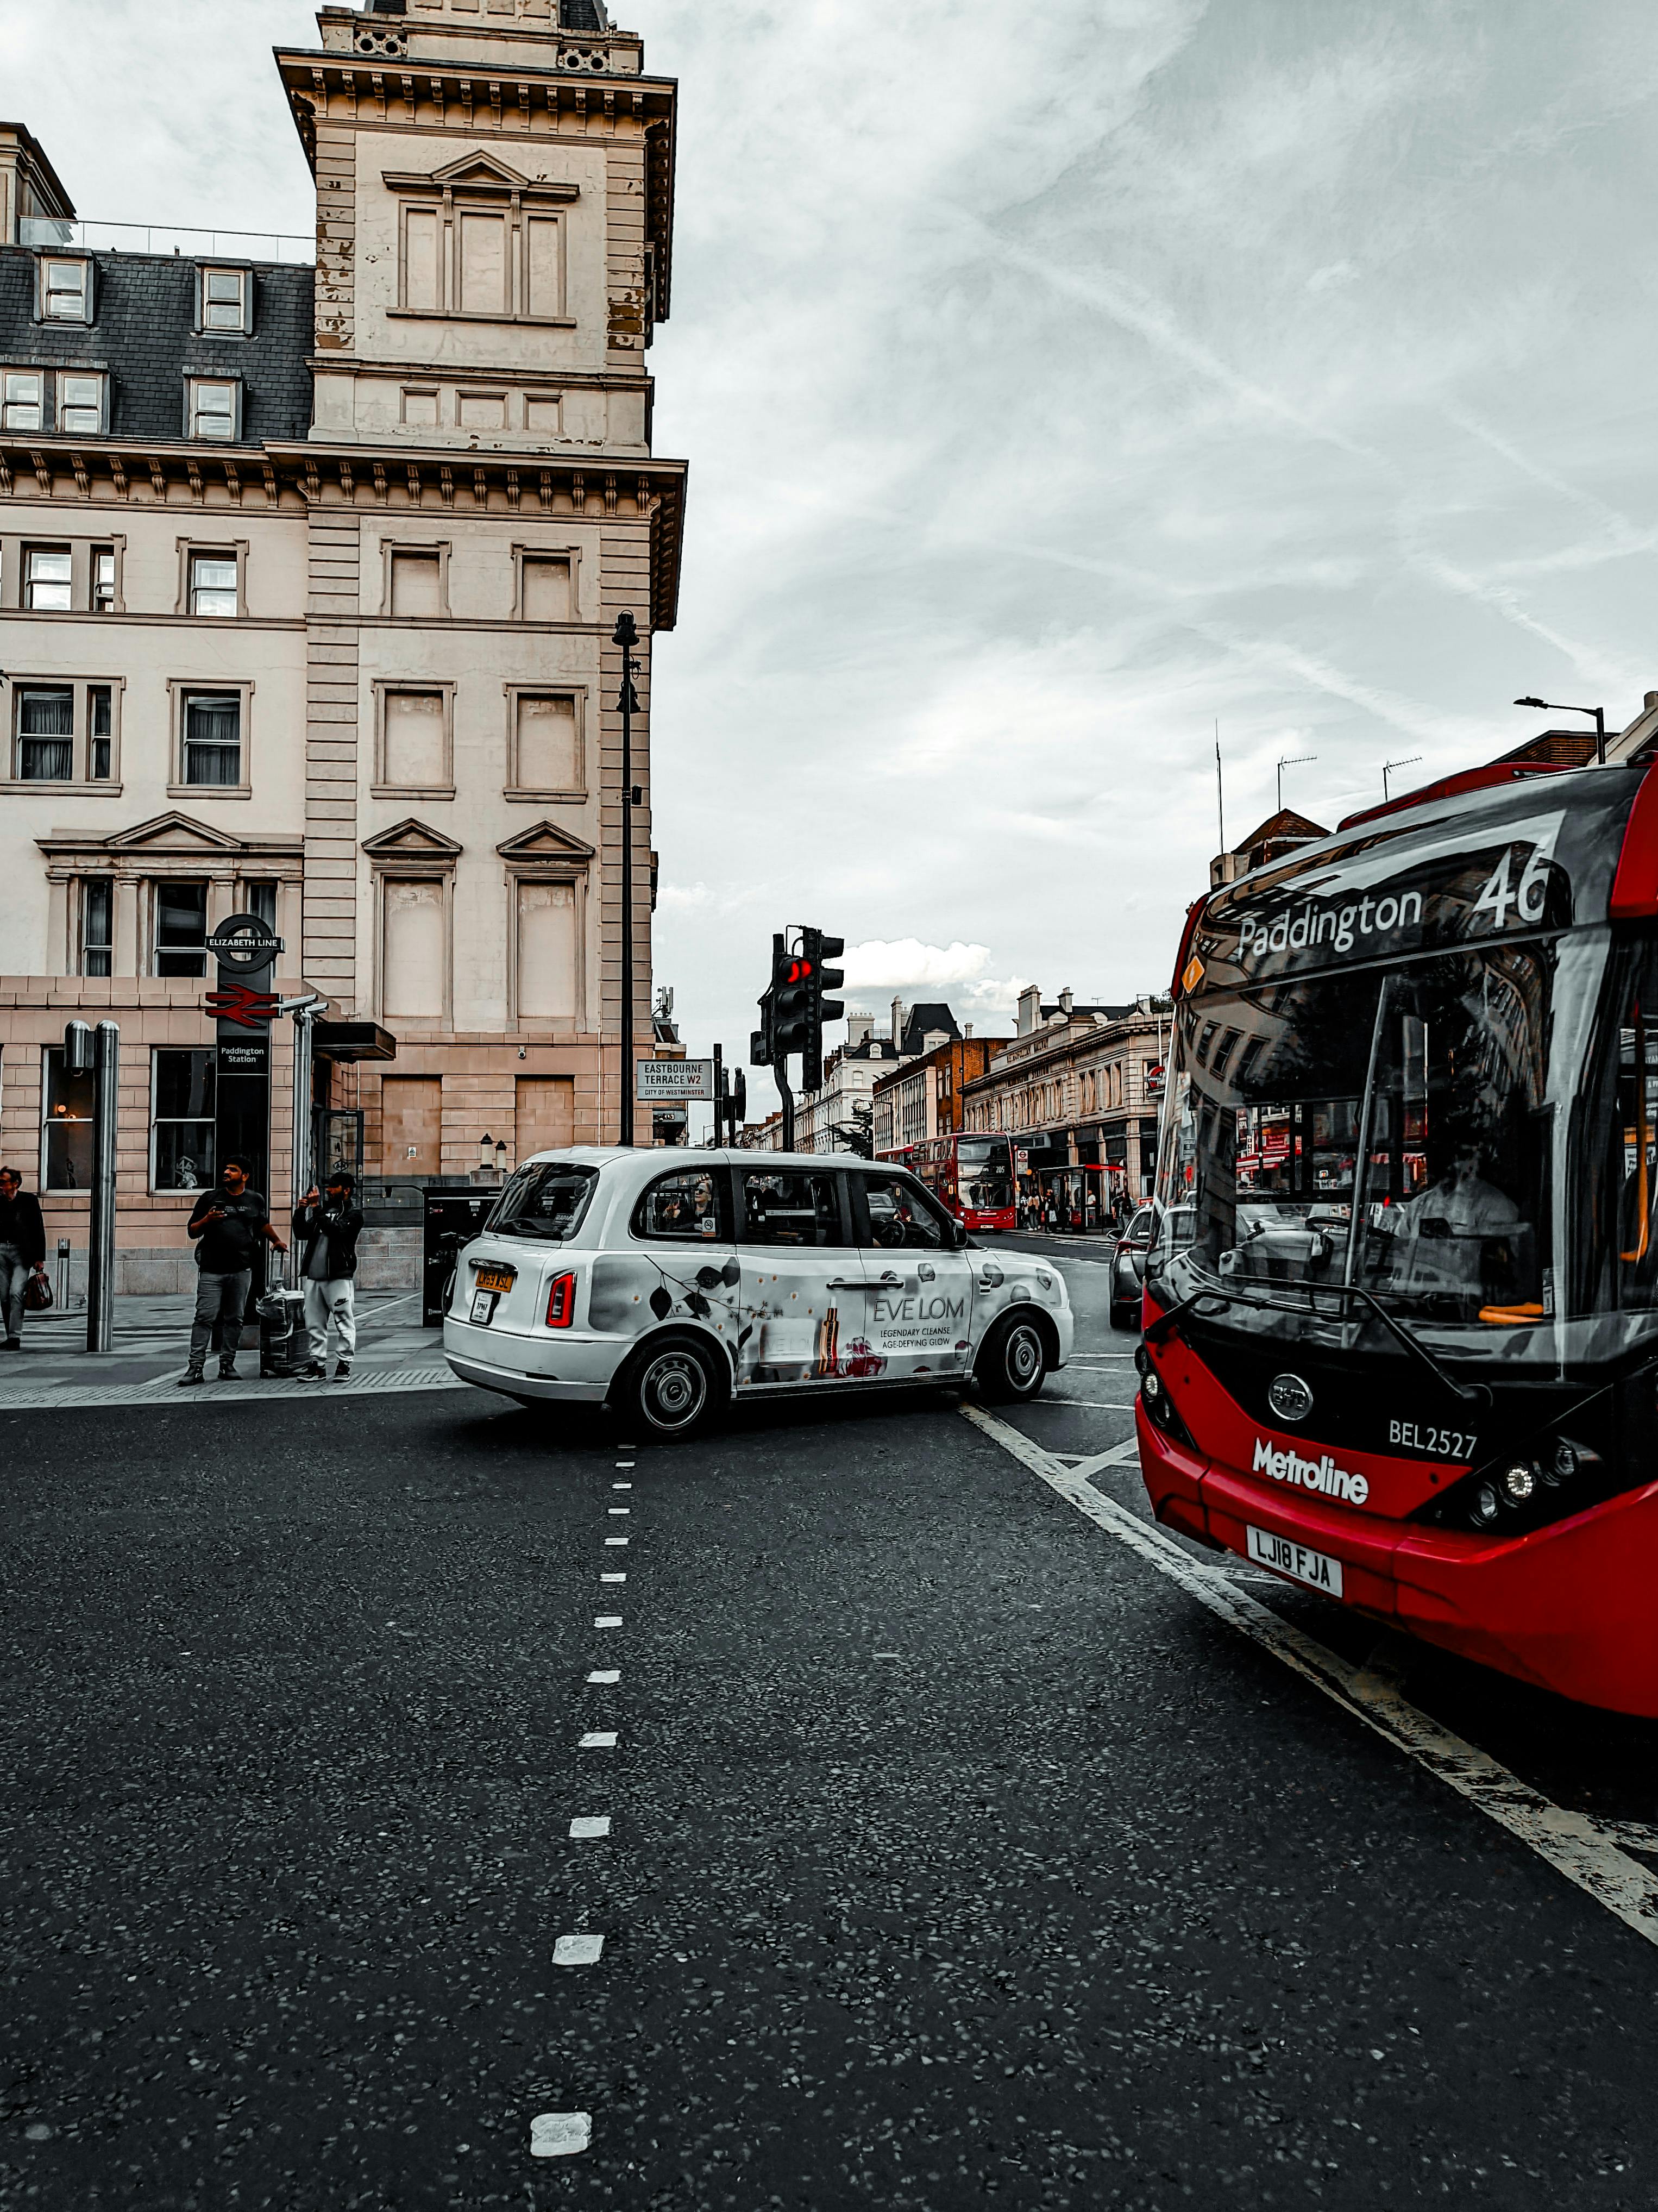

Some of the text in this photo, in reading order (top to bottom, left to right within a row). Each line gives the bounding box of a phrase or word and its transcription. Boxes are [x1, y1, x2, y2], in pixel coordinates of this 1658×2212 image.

[1239, 838, 1550, 959] Paddington 46
[221, 1048, 264, 1056] Paddington
[645, 1064, 703, 1073] EASTBOURNE
[645, 1075, 701, 1084] TERRACE W2
[874, 1297, 964, 1321] EVE LOM
[881, 1327, 952, 1338] LEGENDARY CLEANSE,
[882, 1338, 950, 1349] AGE-DEFYING GLOW
[1390, 1420, 1477, 1459] BEL2527
[1253, 1437, 1368, 1505] Metroline
[1256, 1532, 1330, 1587] LJ18 FJA
